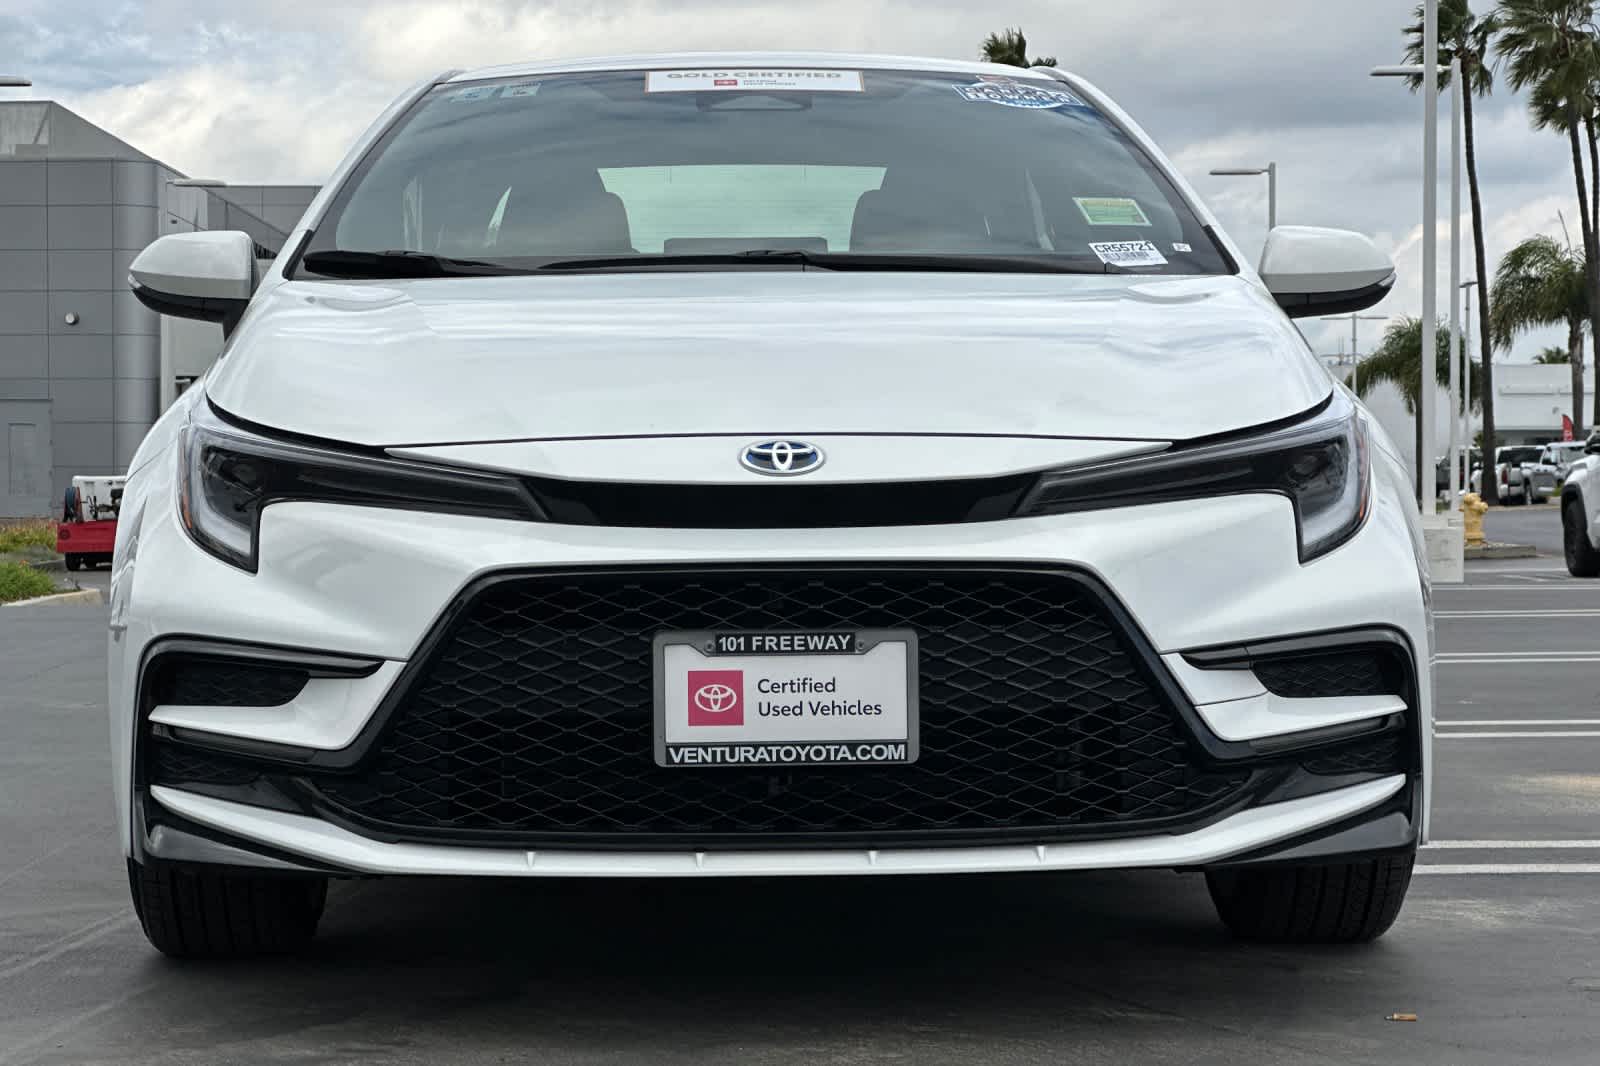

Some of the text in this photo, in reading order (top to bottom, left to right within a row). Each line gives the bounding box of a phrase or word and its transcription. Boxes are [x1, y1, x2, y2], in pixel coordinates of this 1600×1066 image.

[733, 71, 842, 79] CERTIFIED
[718, 634, 851, 652] 101 FREEWAY
[757, 677, 836, 694] Certified
[758, 699, 882, 717] Used Vehicles
[669, 744, 905, 764] VENTURATOYOTA.COM
